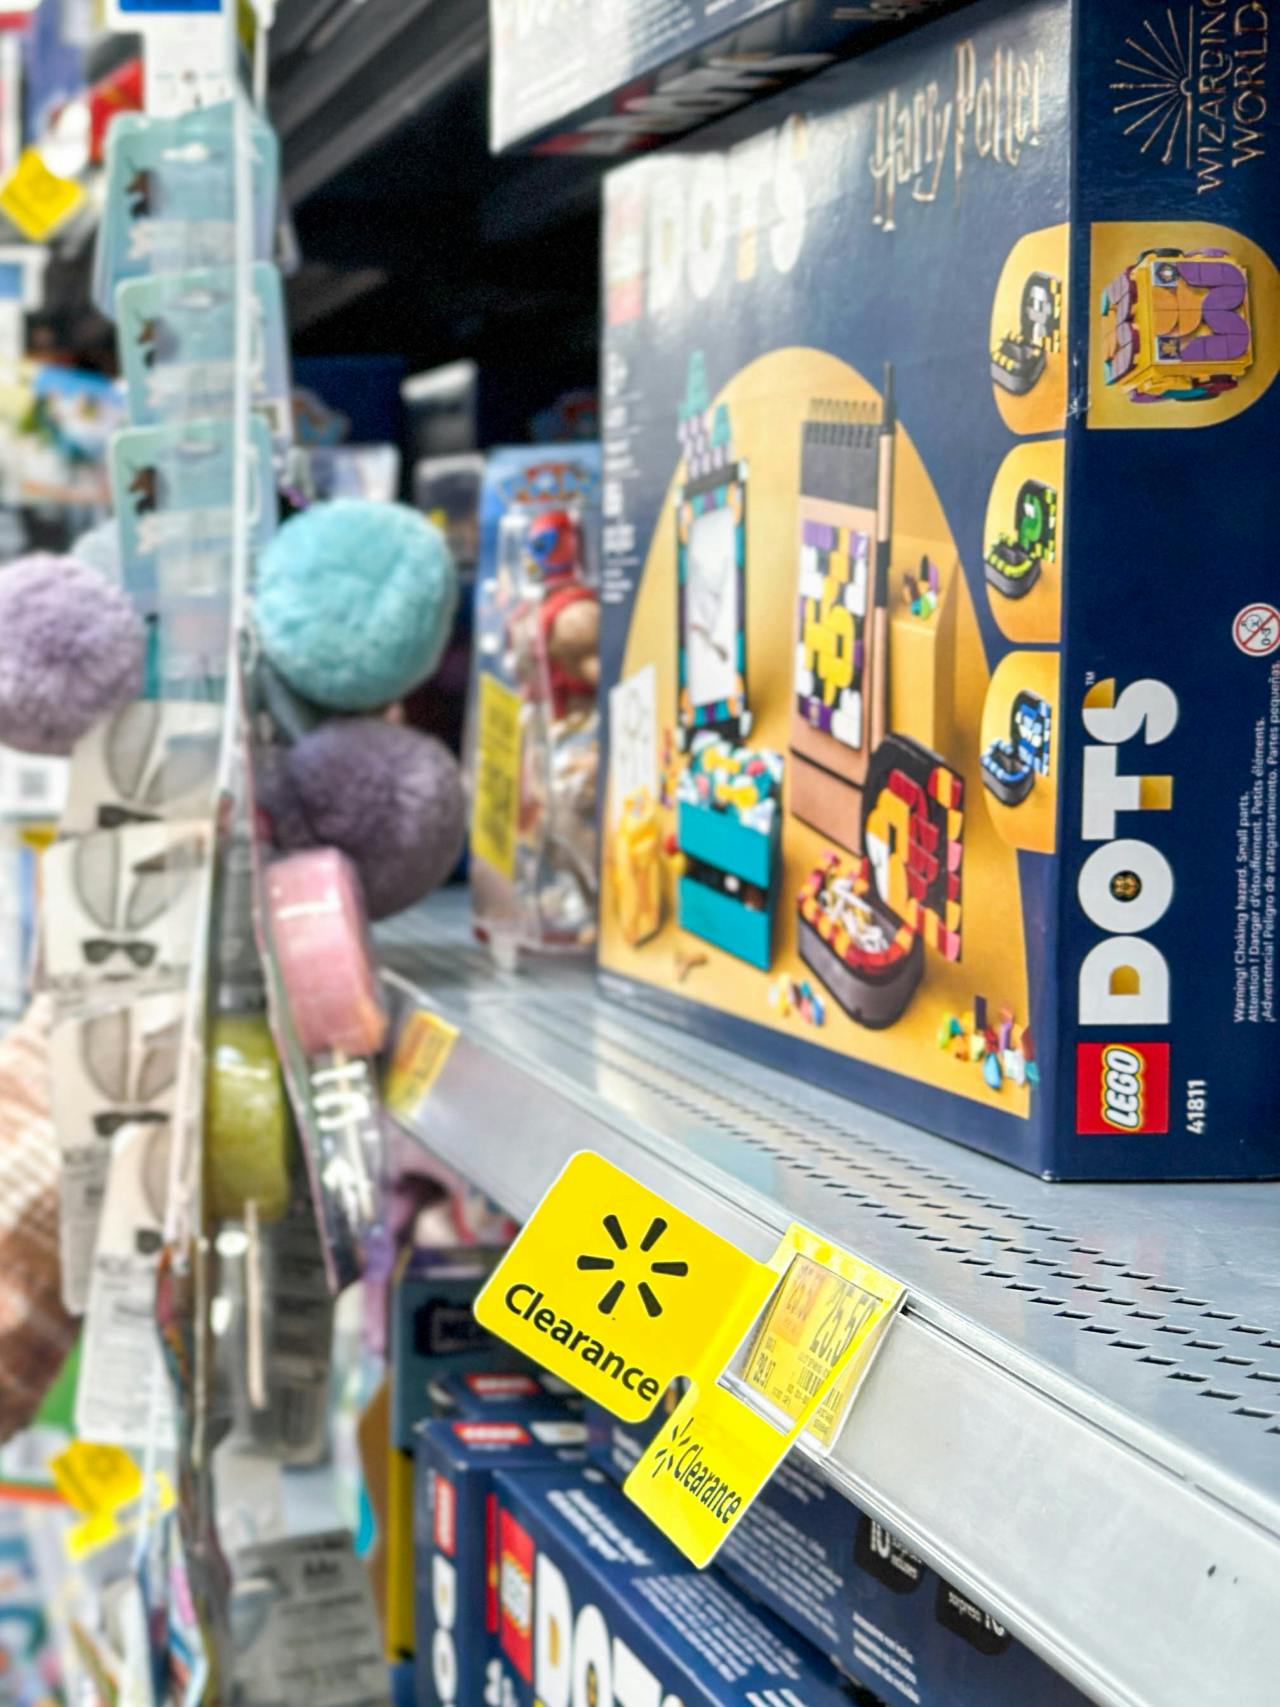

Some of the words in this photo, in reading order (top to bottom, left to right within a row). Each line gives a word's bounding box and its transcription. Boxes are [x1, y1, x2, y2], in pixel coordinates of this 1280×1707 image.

[1231, 2, 1269, 168] WORLD
[869, 80, 952, 232] Harry
[954, 37, 1046, 207] Potter
[1266, 726, 1279, 766] Partes
[1238, 791, 1250, 828] parts.
[1251, 780, 1264, 815] Petits
[1077, 677, 1180, 1026] DOTS
[1236, 829, 1249, 863] Small
[1235, 865, 1248, 911] hazard.
[1264, 876, 1276, 893] de
[1233, 912, 1249, 965] Choking
[1248, 911, 1263, 956] Danger
[1263, 895, 1278, 939] Peligro
[1233, 967, 1249, 1024] Warning!
[1247, 965, 1260, 1023] Attention
[1104, 1047, 1142, 1128] LEGO
[1186, 1079, 1208, 1135] 41811
[504, 1282, 660, 1403] Clearance
[672, 1443, 742, 1525] Clearance
